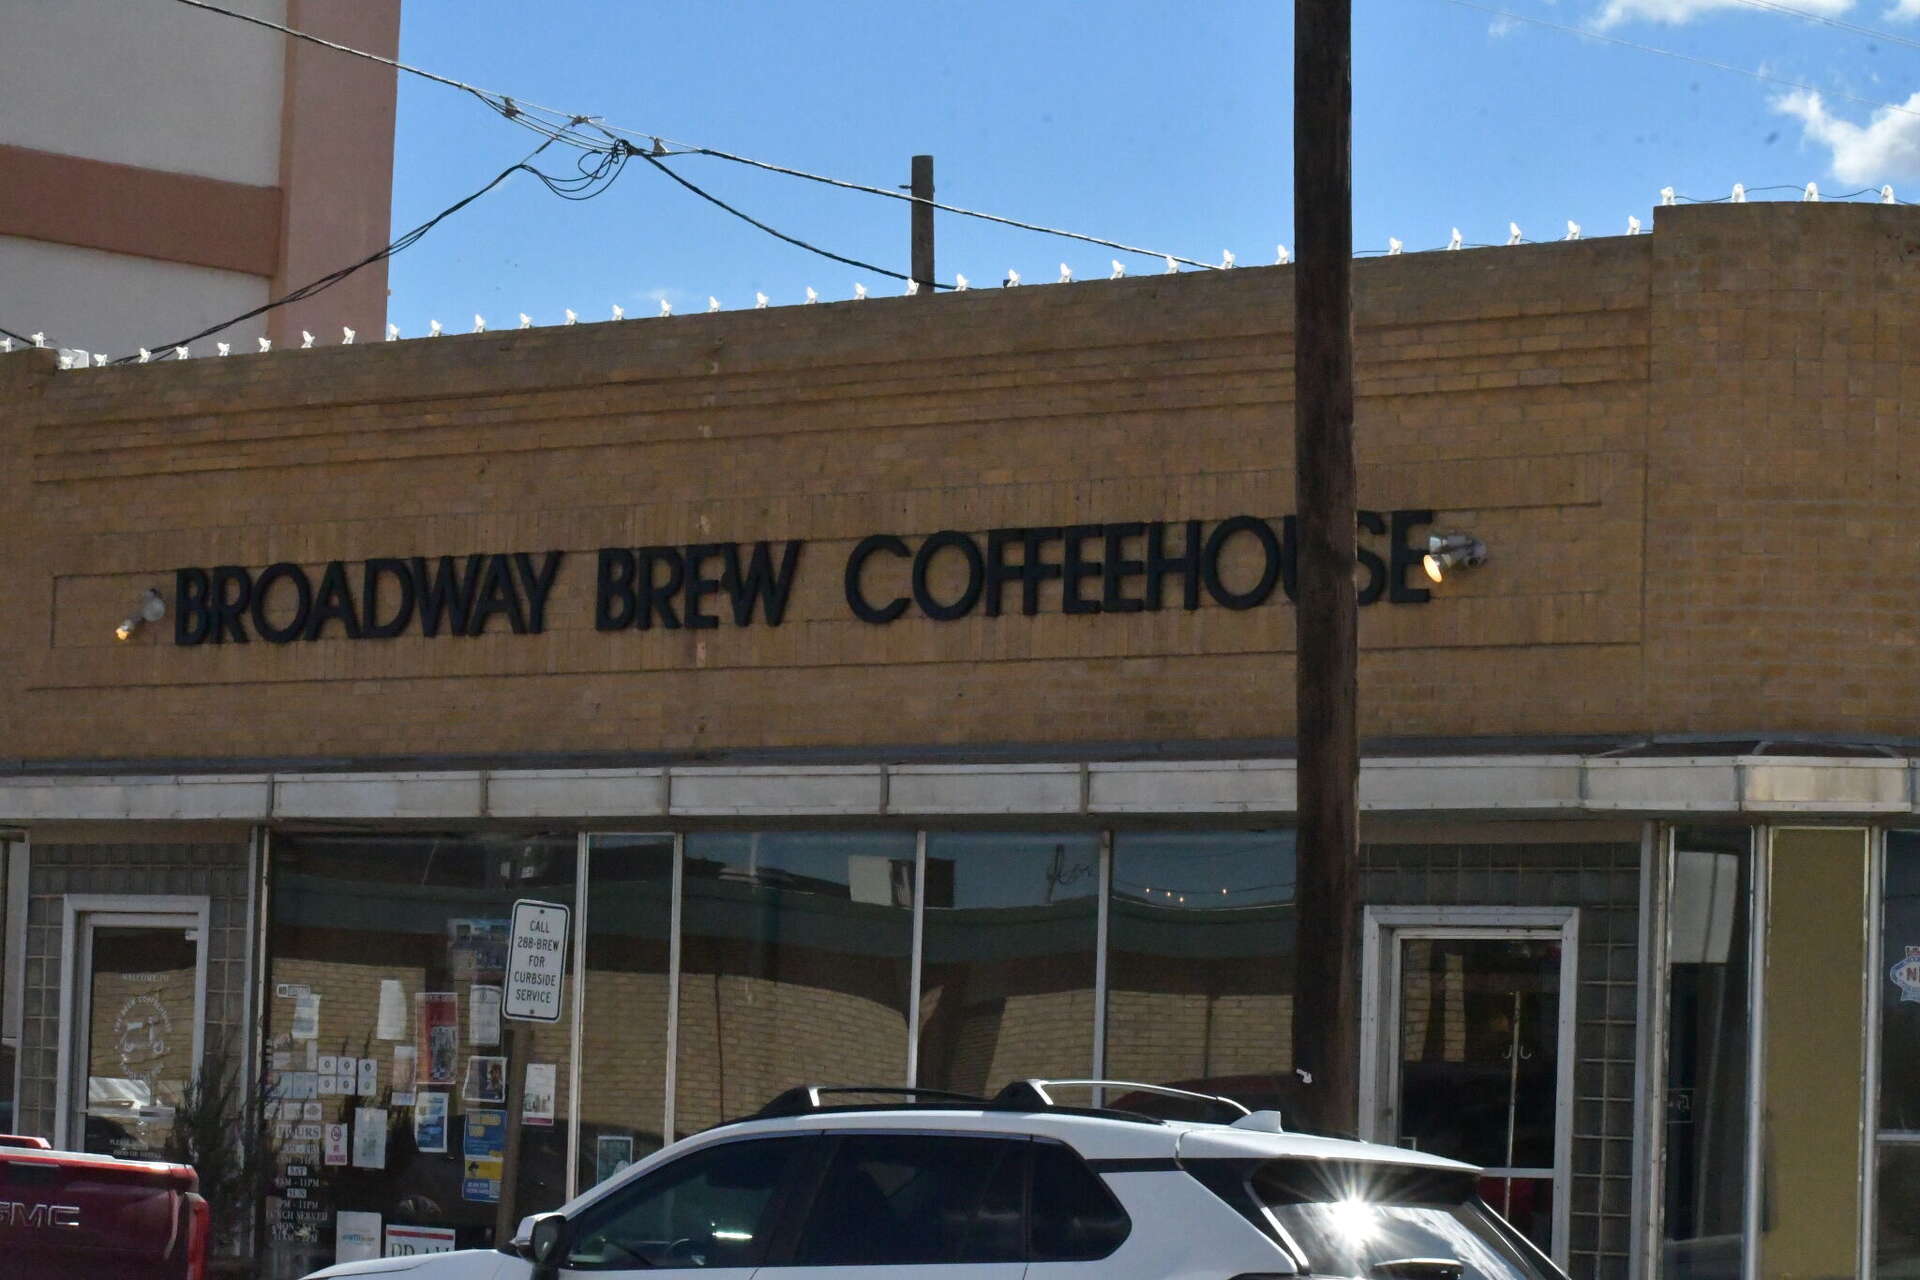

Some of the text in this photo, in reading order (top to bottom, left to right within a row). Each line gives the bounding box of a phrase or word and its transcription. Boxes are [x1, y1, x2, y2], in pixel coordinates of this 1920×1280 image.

[175, 510, 1433, 645] BROADWAY BREW COFFEEHOSE
[530, 920, 550, 933] CALL
[528, 955, 545, 968] FOR
[514, 971, 556, 987] CURBSIDE
[515, 989, 552, 1004] SERVICE
